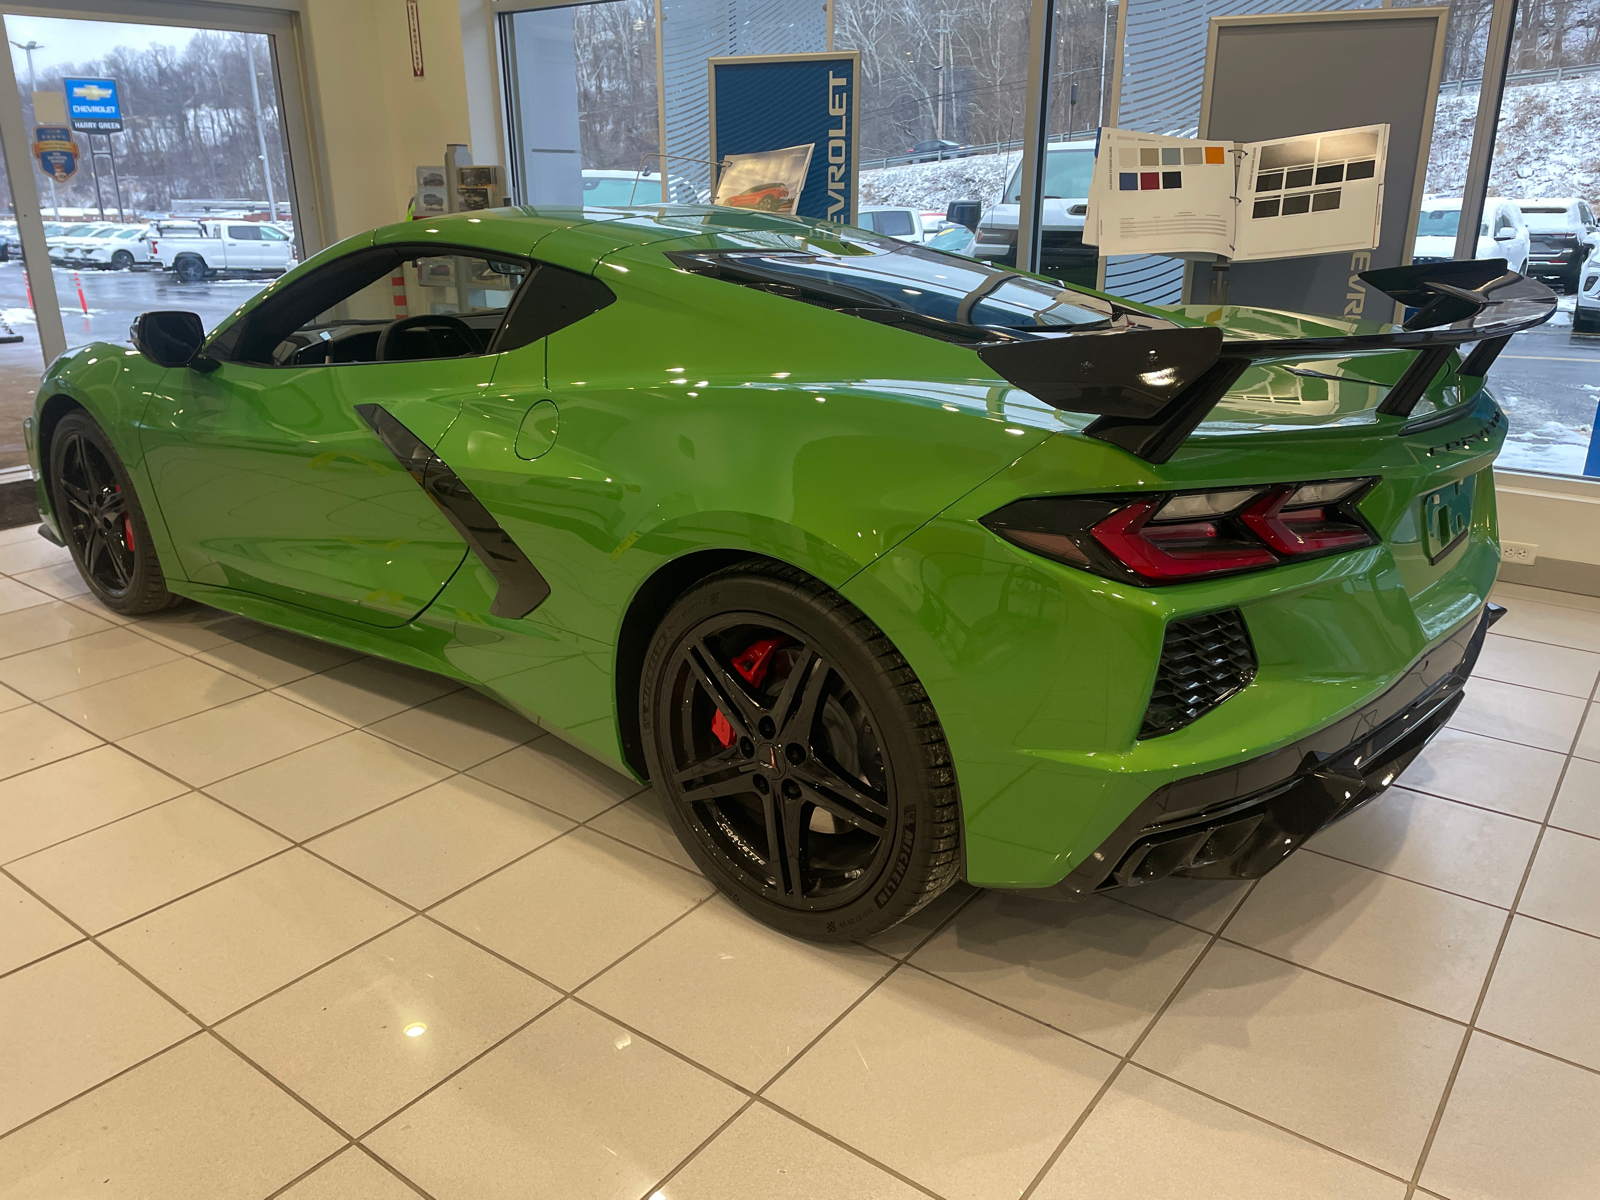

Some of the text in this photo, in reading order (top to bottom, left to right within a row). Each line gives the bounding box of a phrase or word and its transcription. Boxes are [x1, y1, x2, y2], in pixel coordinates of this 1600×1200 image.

[410, 4, 420, 71] EXTINGUISHER
[72, 105, 115, 113] CHEVROLET
[74, 121, 120, 130] HARRY GREEN
[1343, 252, 1371, 319] EVR
[643, 634, 666, 707] MICHELIN
[721, 823, 766, 866] CORVETTE
[878, 829, 914, 905] MICHELIN
